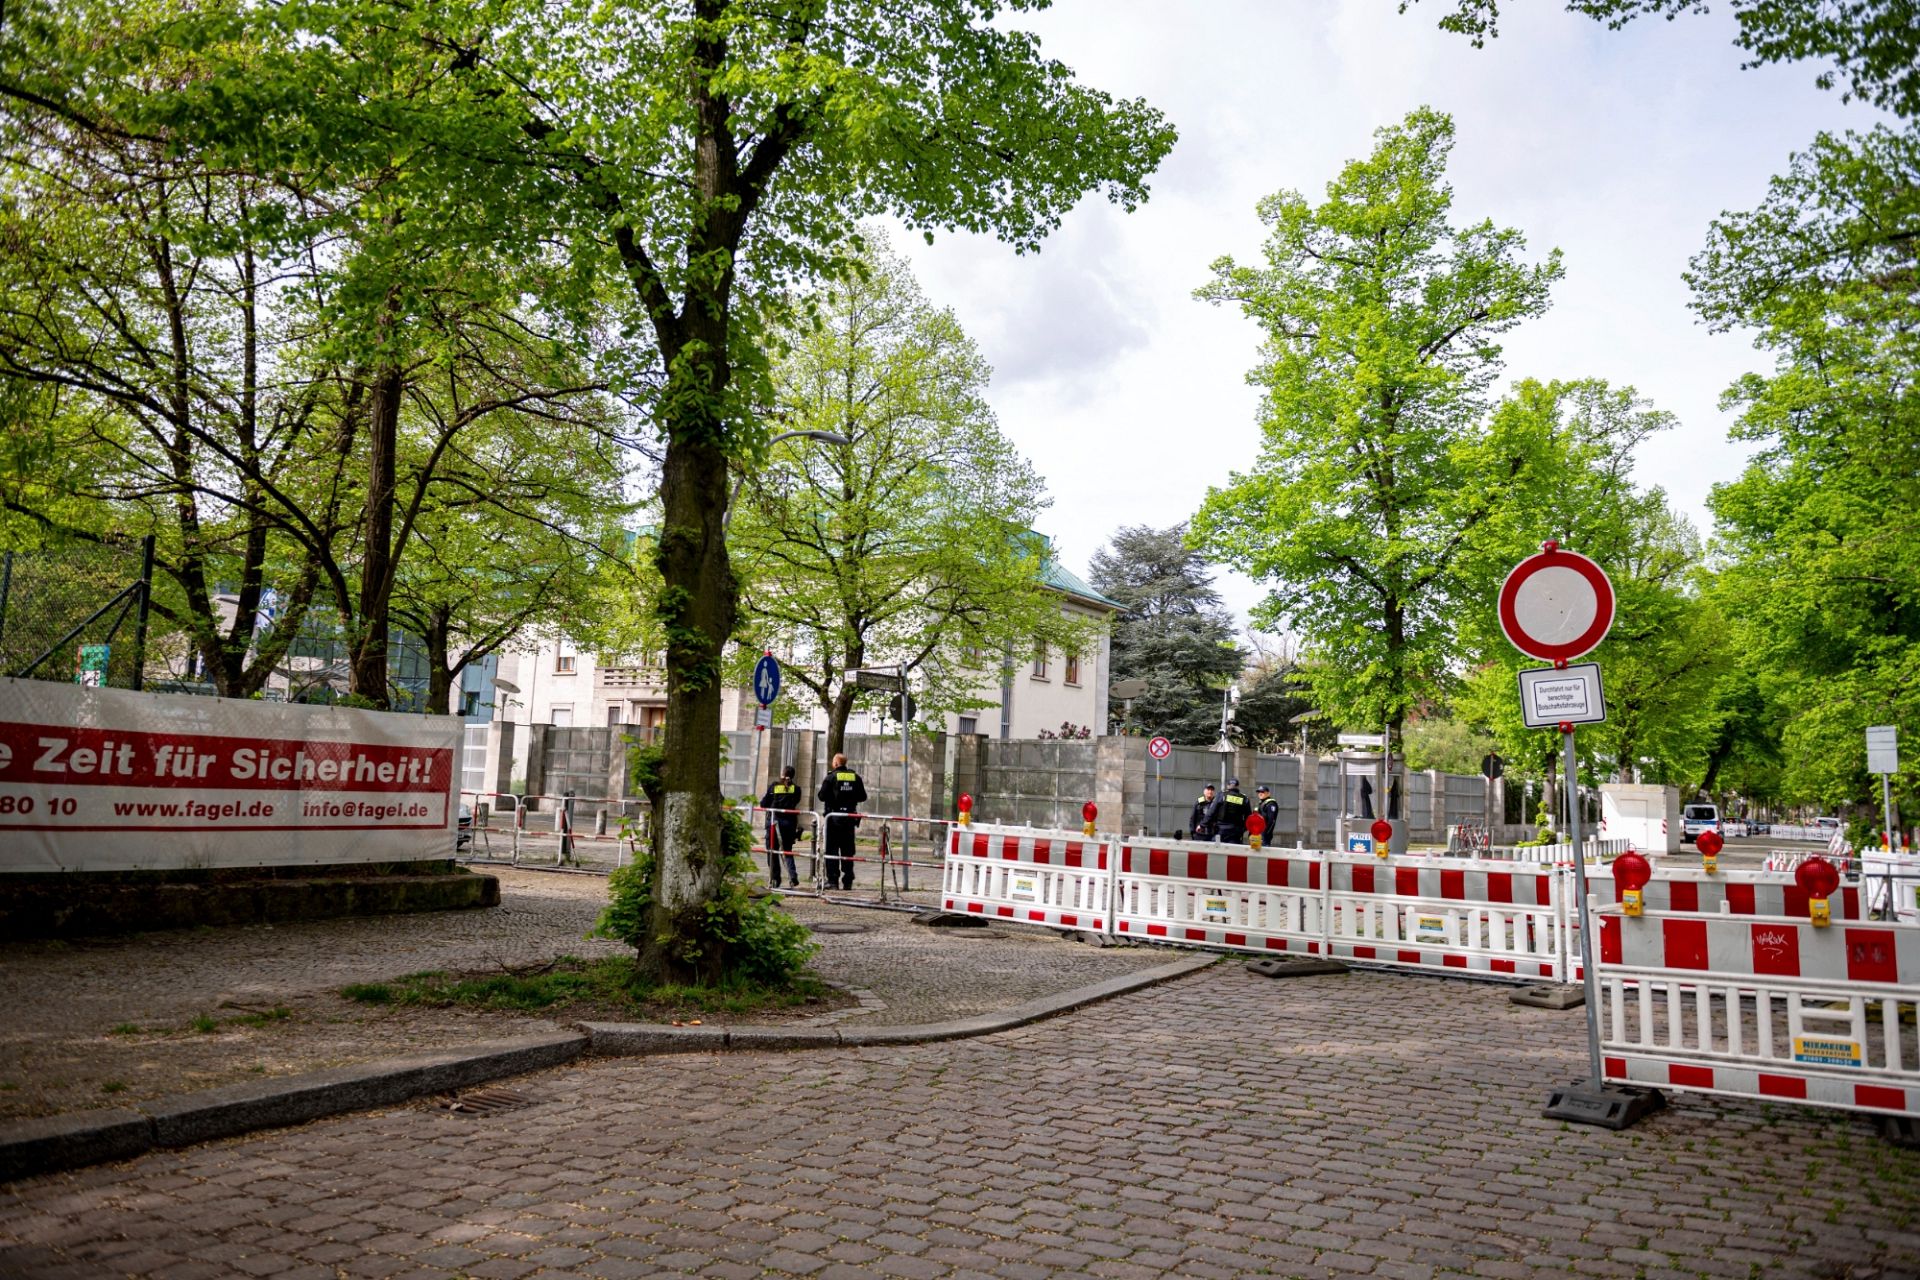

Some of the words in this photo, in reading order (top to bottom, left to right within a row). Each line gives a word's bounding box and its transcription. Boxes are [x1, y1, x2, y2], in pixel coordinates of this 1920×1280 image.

[33, 737, 136, 775] Zeit
[154, 745, 217, 778] für
[230, 748, 432, 784] Sicherheit!
[47, 798, 78, 815] 10
[114, 800, 274, 820] www.fagel.de
[303, 801, 428, 820] info@fagel.de
